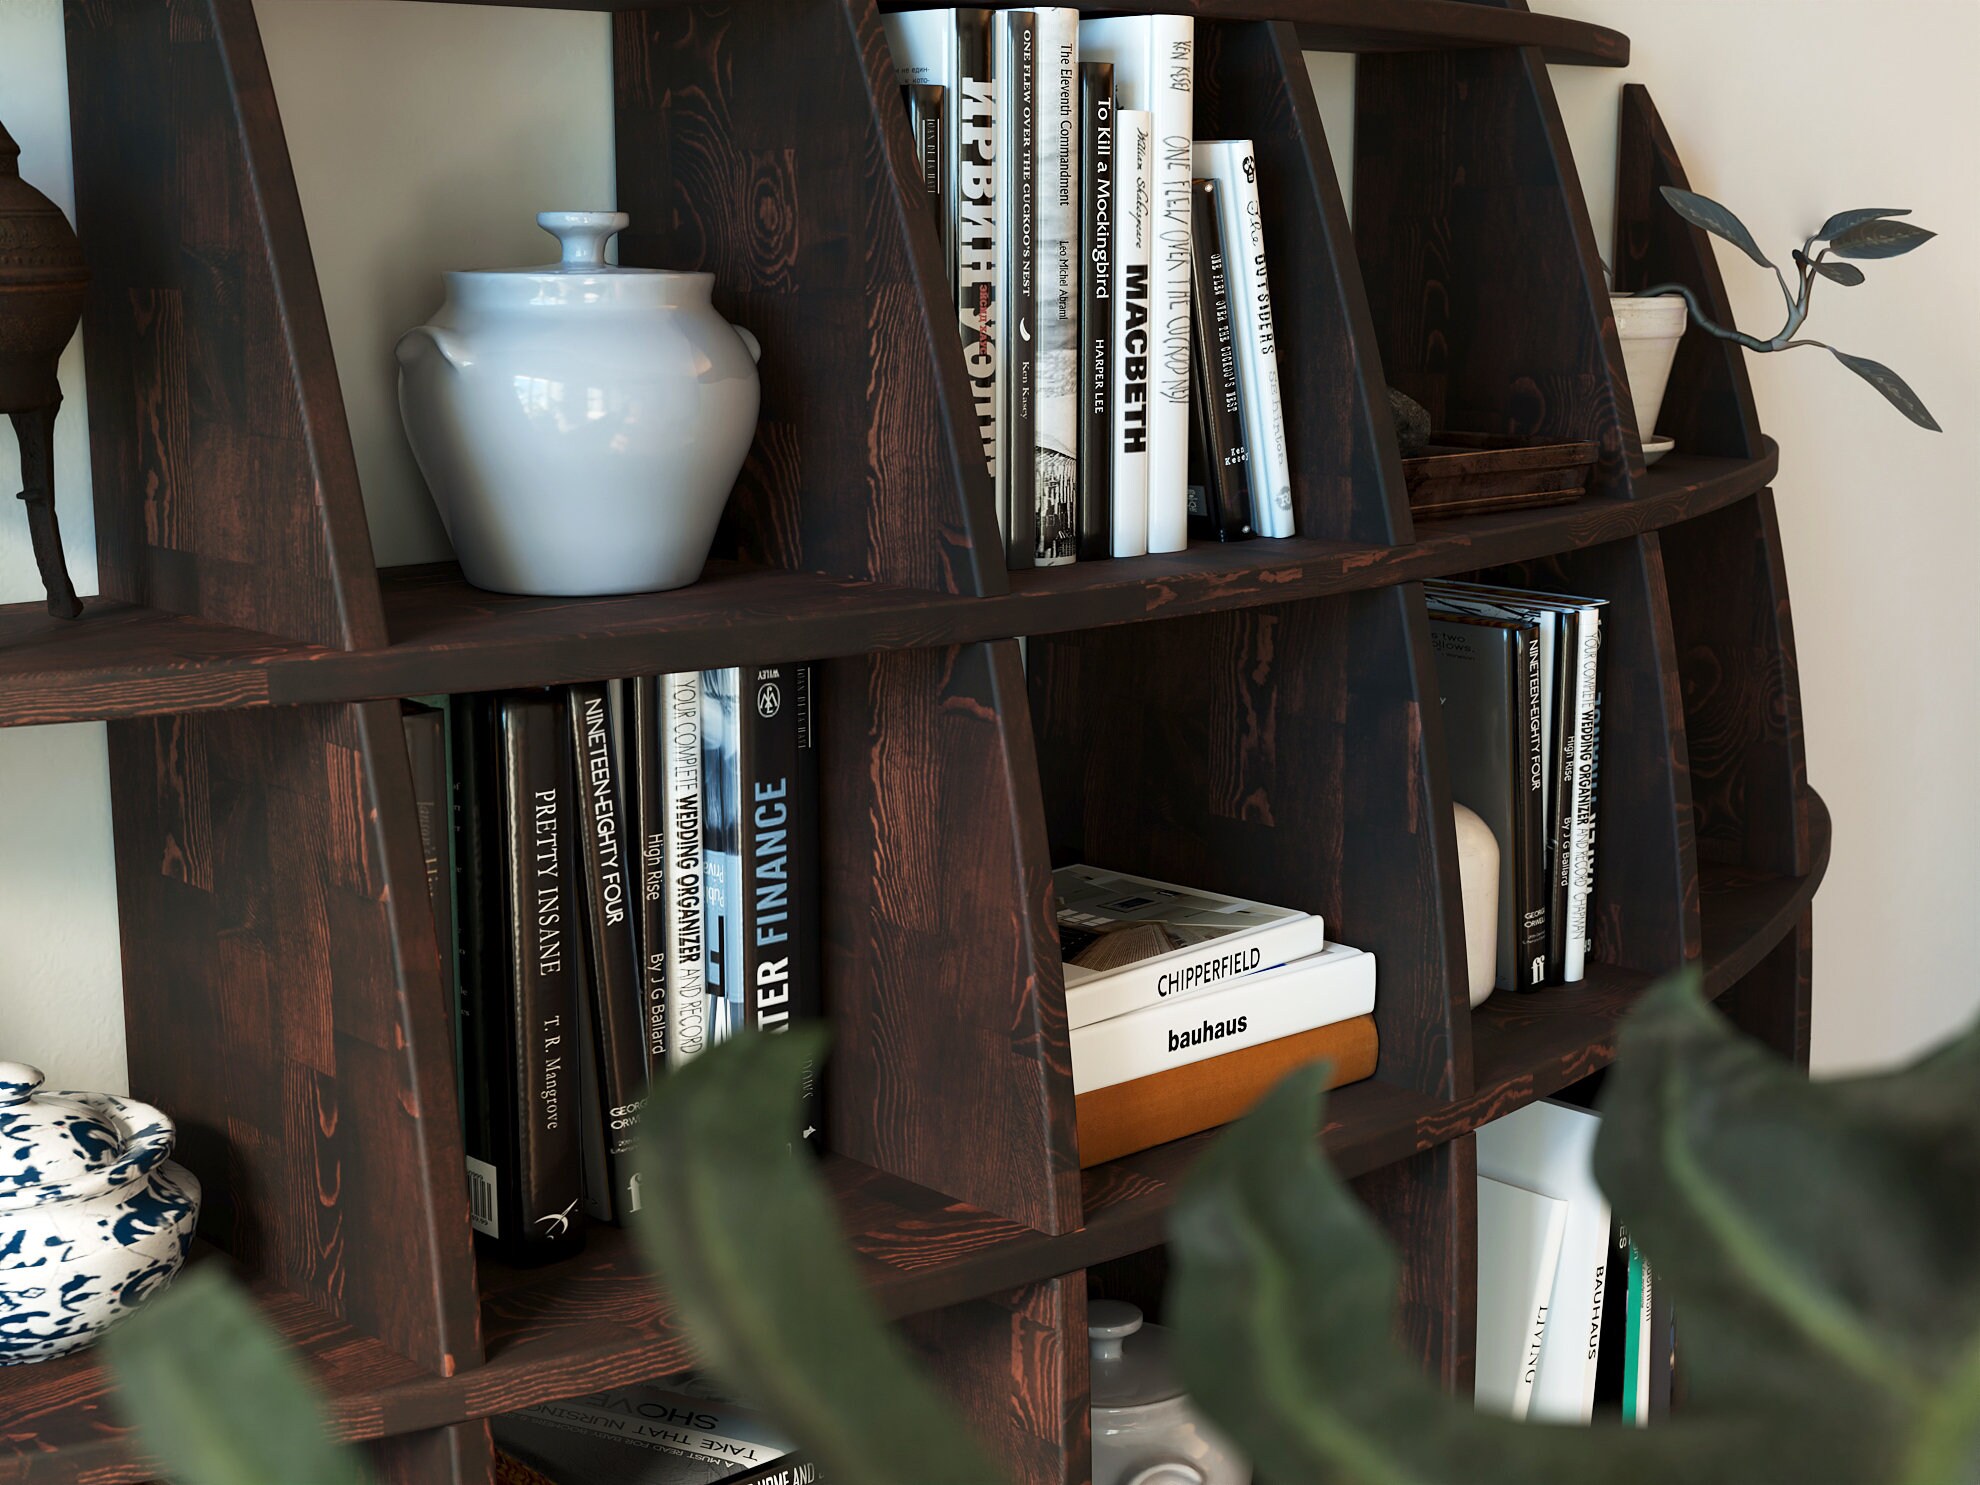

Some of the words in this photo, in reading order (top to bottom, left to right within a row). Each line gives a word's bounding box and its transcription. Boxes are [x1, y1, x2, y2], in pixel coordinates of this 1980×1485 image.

[1023, 29, 1031, 61] ONE
[1060, 43, 1073, 65] The
[1170, 40, 1191, 60] KEN
[1023, 64, 1031, 103] FLEW
[1060, 68, 1073, 116] Eleventh
[1169, 65, 1191, 93] KESEY
[1097, 97, 1111, 121] To
[1023, 106, 1031, 147] OVER
[1097, 126, 1111, 155] Kill
[1023, 149, 1031, 180] THE
[1059, 120, 1072, 206] Commandment
[1135, 127, 1149, 171] William
[1163, 135, 1191, 172] ONE
[961, 76, 997, 287] ИРВИН
[1097, 162, 1108, 173] a
[1129, 176, 1149, 249] Shakespeare
[1163, 179, 1191, 225] FLEW
[1022, 183, 1031, 258] CUCKOO'S
[1247, 200, 1262, 246] The
[1059, 240, 1069, 256] Leo
[1092, 178, 1110, 299] Mockingbird
[1159, 230, 1191, 272] OVER
[1210, 253, 1222, 271] ONE
[1022, 260, 1030, 297] NEST
[1166, 278, 1191, 310] THE
[1212, 274, 1225, 296] FLEW
[978, 284, 989, 323] ЭЙСИД
[1215, 299, 1228, 322] OVER
[1254, 253, 1275, 355] OUTSIDERS
[978, 325, 989, 356] ХАУС
[1218, 325, 1230, 343] THE
[1021, 361, 1030, 383] Ken
[1094, 339, 1105, 390] HARPER
[1124, 264, 1148, 453] MACBETH
[1219, 346, 1236, 388] CUCKOO'S
[1094, 392, 1104, 414] LEE
[1160, 379, 1190, 404] NEST
[1225, 391, 1238, 413] NEST
[1230, 446, 1245, 457] Ken
[1583, 632, 1597, 659] YOUR
[758, 668, 780, 681] WILEY
[1582, 660, 1596, 709] COMPLETE
[673, 679, 697, 718] YOUR
[1528, 639, 1540, 752] NINETEEN-EIGHTY
[1563, 736, 1575, 758] High
[1580, 709, 1594, 761] WEDDING
[673, 722, 698, 792] COMPLETE
[1531, 755, 1541, 791] FOUR
[1564, 761, 1574, 782] Rise
[1577, 764, 1593, 826] ORGANIZER
[584, 698, 620, 868] NINETEEN-EIGHTY
[602, 872, 624, 927] FOUR
[1562, 817, 1572, 830] By
[535, 788, 559, 878] PRETTY
[676, 793, 699, 870] WEDDING
[1562, 840, 1570, 849] G
[1575, 828, 1589, 849] AND
[643, 833, 664, 866] High
[755, 777, 788, 947] FINANCE
[645, 869, 664, 901] Rise
[703, 863, 724, 883] Priva
[1561, 852, 1571, 887] Ballard
[678, 873, 701, 964] ORGANIZER
[1524, 906, 1545, 919] GEORG
[1524, 916, 1545, 928] ORWEL
[537, 886, 562, 976] INSANE
[647, 952, 665, 972] By
[1157, 946, 1261, 998] CHIPPERFIELD
[651, 987, 665, 1000] G
[679, 968, 702, 998] AND
[543, 1015, 560, 1032] T.
[651, 1004, 667, 1055] Ballard
[679, 1001, 703, 1055] RECORD
[1168, 1014, 1248, 1053] bauhaus
[544, 1035, 561, 1053] R.
[540, 1057, 562, 1130] Mangrove
[609, 1098, 648, 1117] GEORG
[1588, 1265, 1605, 1360] BAUHAUS
[1524, 1305, 1549, 1384] LIVING
[631, 1425, 691, 1446] THAT
[651, 1445, 684, 1457] READ
[699, 1437, 758, 1463] TAKE
[686, 1452, 721, 1465] MUST
[724, 1460, 735, 1469] A
[793, 1462, 815, 1485] AND
